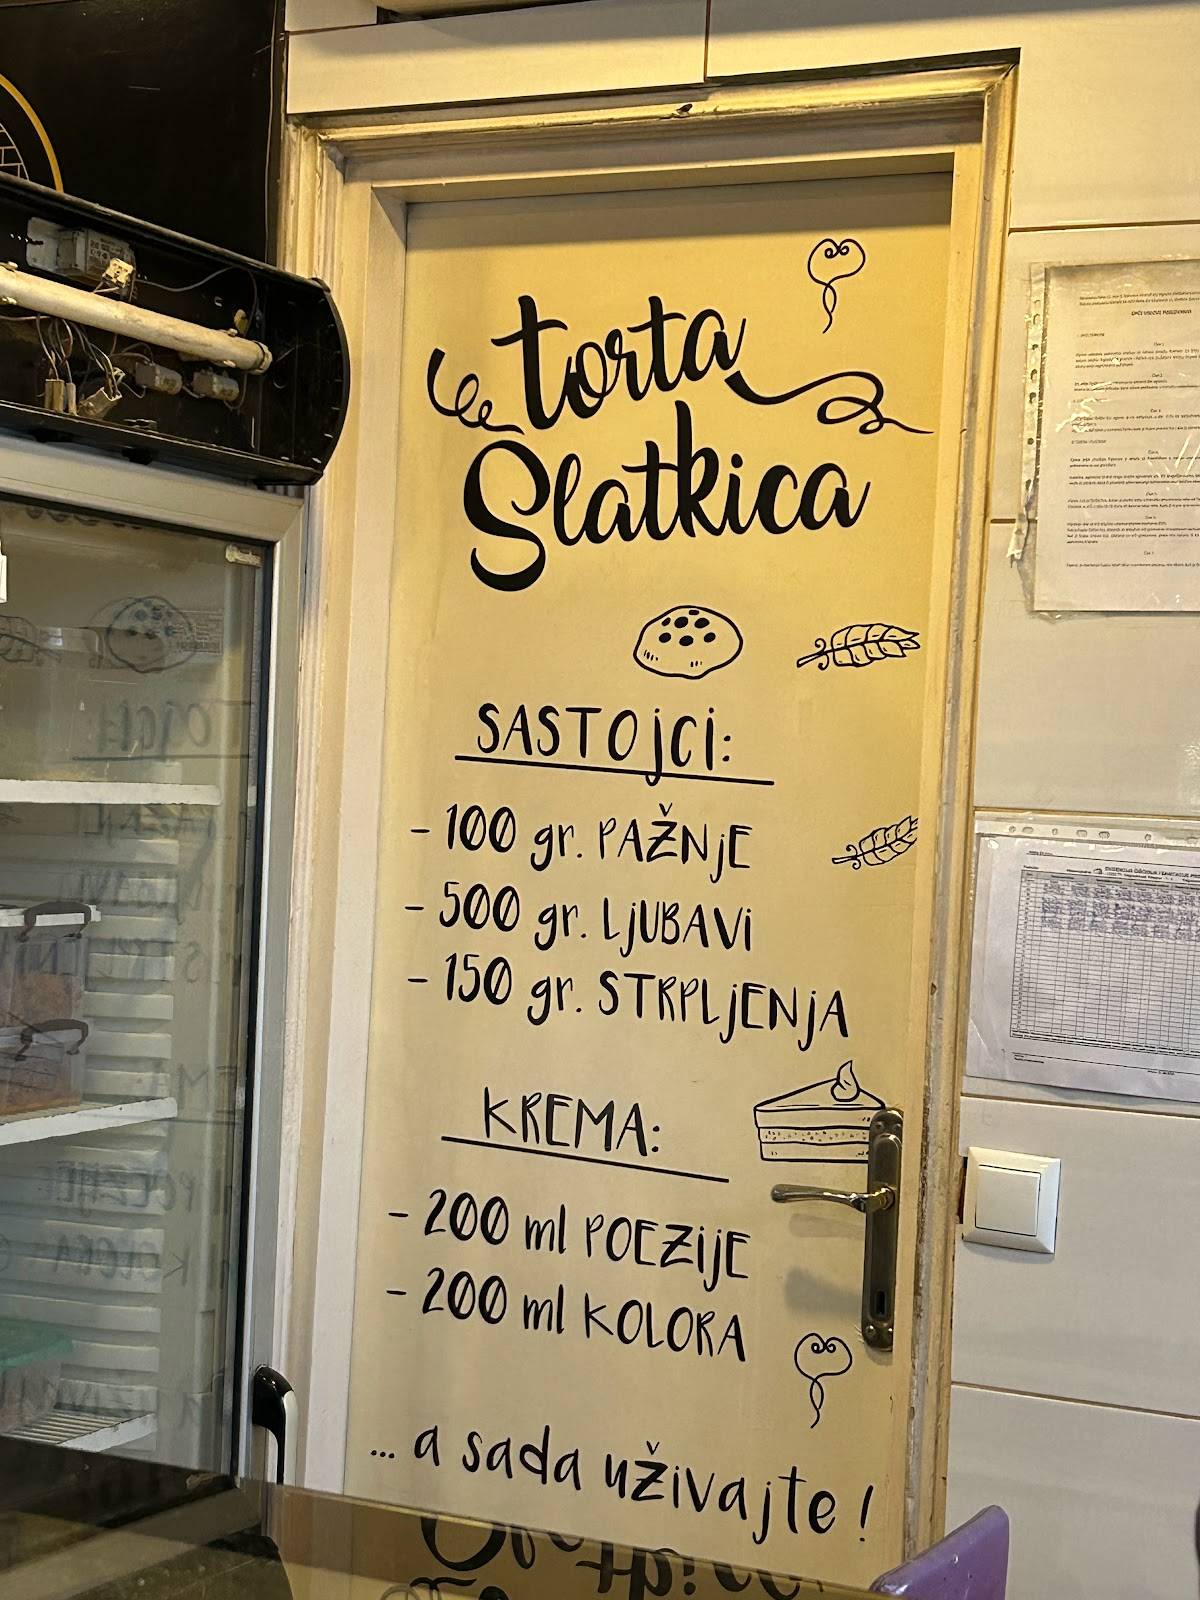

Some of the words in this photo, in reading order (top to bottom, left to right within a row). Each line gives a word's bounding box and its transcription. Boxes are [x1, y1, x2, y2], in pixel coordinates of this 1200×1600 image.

[490, 294, 746, 430] torta
[463, 400, 870, 592] Slatkica
[446, 803, 517, 854] 100
[530, 823, 583, 872] gr.
[438, 881, 520, 933] 500
[534, 903, 587, 952] gr.
[445, 952, 512, 1006] 150
[526, 975, 582, 1027] gr.
[483, 1087, 661, 1156] KREMA:
[423, 1188, 509, 1246] 200
[524, 1203, 566, 1255] ml
[421, 1266, 507, 1325] 200
[523, 1283, 565, 1335] ml
[584, 1292, 746, 1363] KOLORA
[413, 1425, 440, 1467] a
[461, 1424, 582, 1491] sada
[604, 1440, 836, 1545] uživajte
